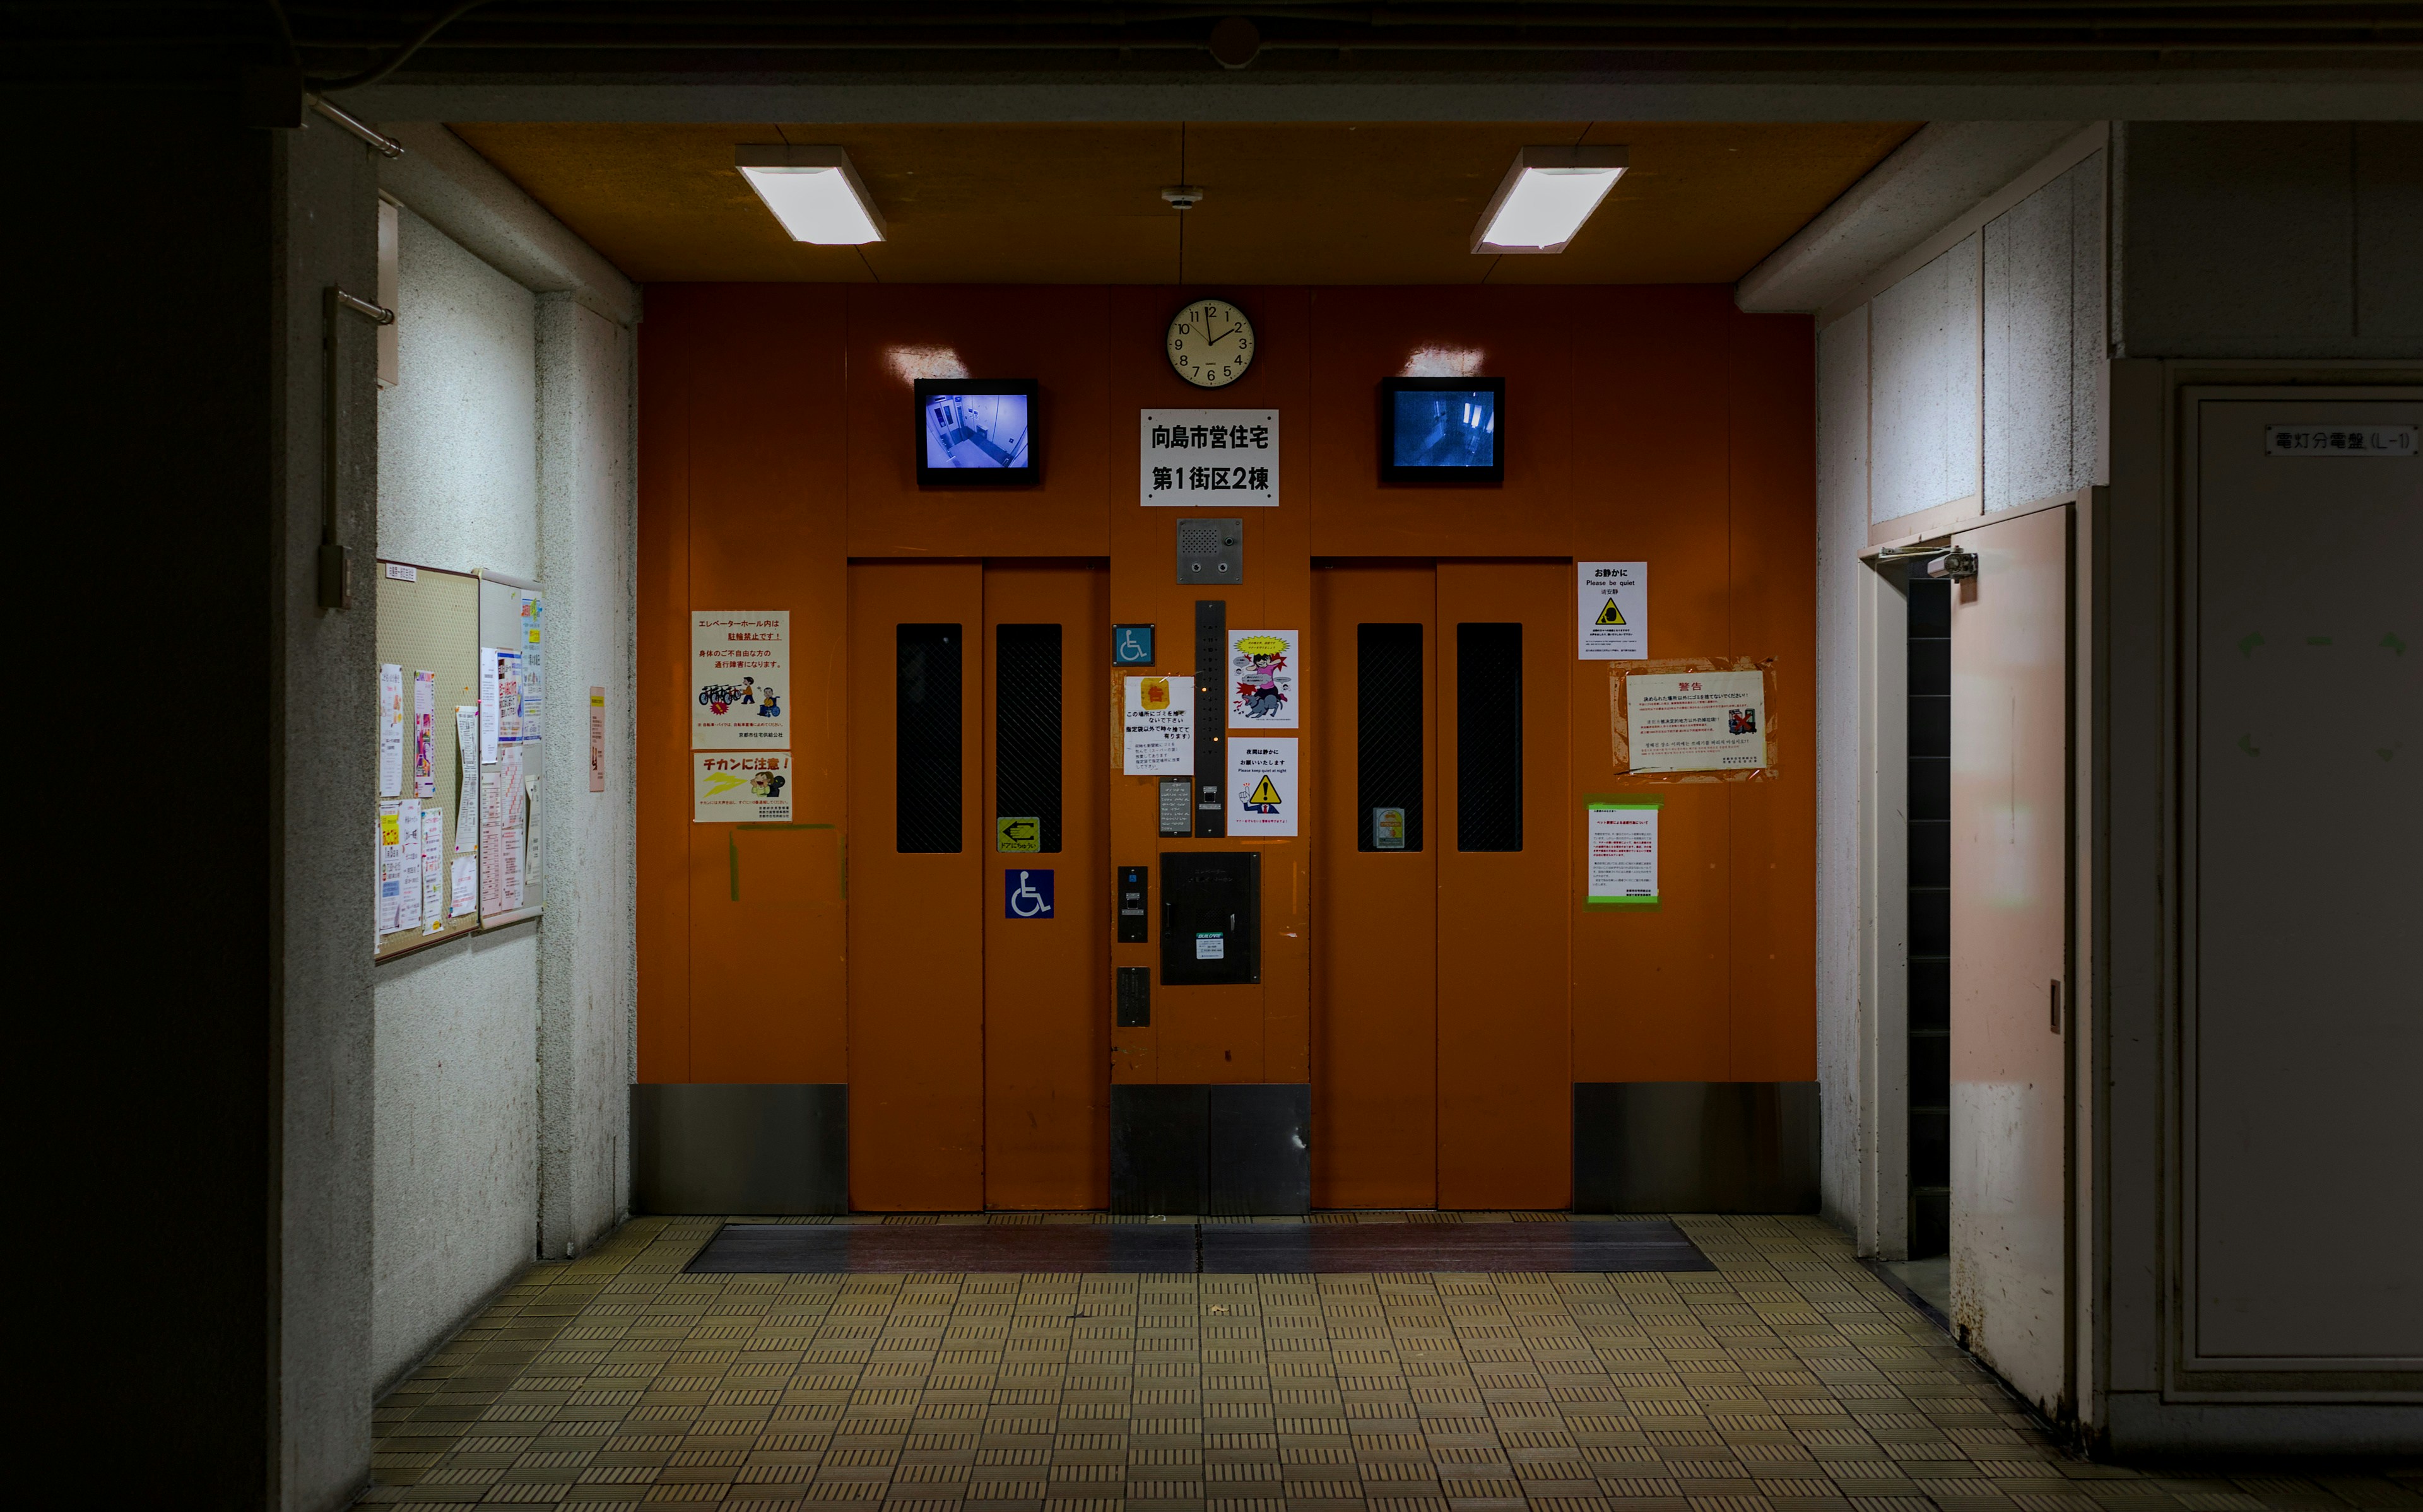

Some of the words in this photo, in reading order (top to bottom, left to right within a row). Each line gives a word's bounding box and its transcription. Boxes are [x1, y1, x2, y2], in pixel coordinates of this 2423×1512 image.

[1189, 311, 1199, 322] 11
[1225, 311, 1229, 322] 1
[1177, 324, 1190, 335] 10
[1234, 322, 1243, 333] 2
[1174, 339, 1182, 351] 9
[1239, 339, 1247, 349] 3
[1179, 355, 1188, 366] 8
[1234, 355, 1243, 366] 4
[1192, 366, 1200, 377] 7
[1206, 370, 1215, 381] 6
[1223, 366, 1232, 377] 5
[1152, 425, 1269, 449] 向島市営住宅
[1152, 467, 1269, 491] 第1街区2棟
[1595, 569, 1628, 577] お静かに
[1678, 682, 1703, 691] 警告
[704, 758, 789, 770] チカンに注意！
